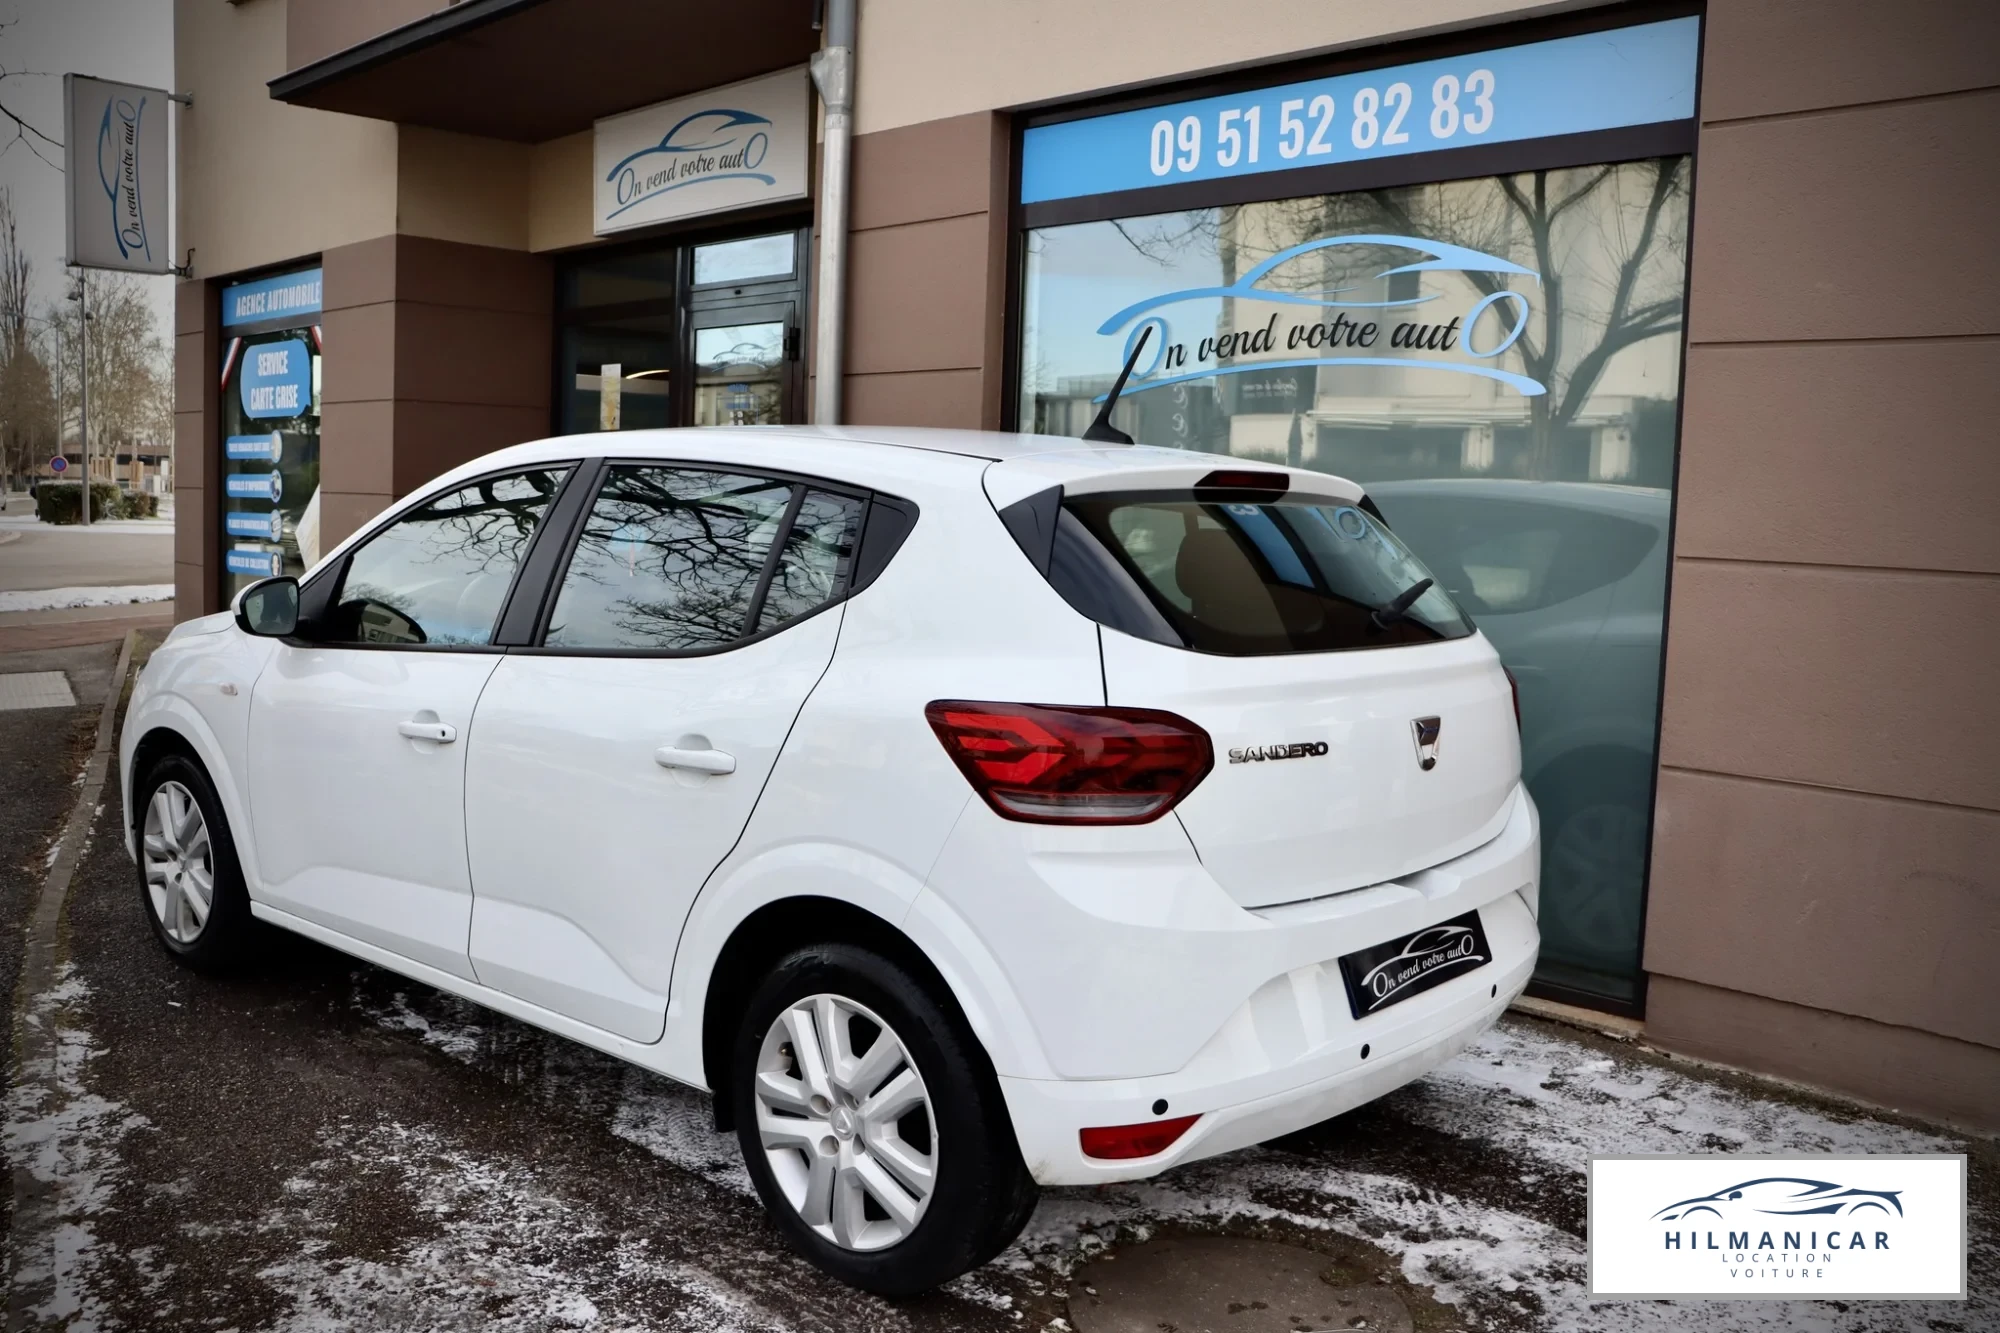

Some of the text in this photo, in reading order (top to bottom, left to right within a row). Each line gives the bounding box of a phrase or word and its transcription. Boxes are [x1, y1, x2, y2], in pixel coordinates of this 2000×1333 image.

[1150, 68, 1496, 177] 09 51 52 82 83
[121, 148, 134, 182] votre
[617, 167, 642, 205] On
[646, 158, 677, 191] vend
[681, 153, 715, 179] votre
[121, 184, 138, 217] vend
[121, 222, 144, 249] On
[236, 281, 321, 318] AGENCE AUTOMOBILE
[1123, 316, 1188, 380] On
[1198, 312, 1278, 363] vend
[1287, 316, 1380, 350] votre
[257, 350, 289, 377] SERVICE
[250, 384, 299, 411] CARTE GRISE
[1229, 741, 1329, 764] SANDERO
[1372, 971, 1396, 998] On
[1398, 958, 1420, 983] vend
[1422, 952, 1446, 970] votre
